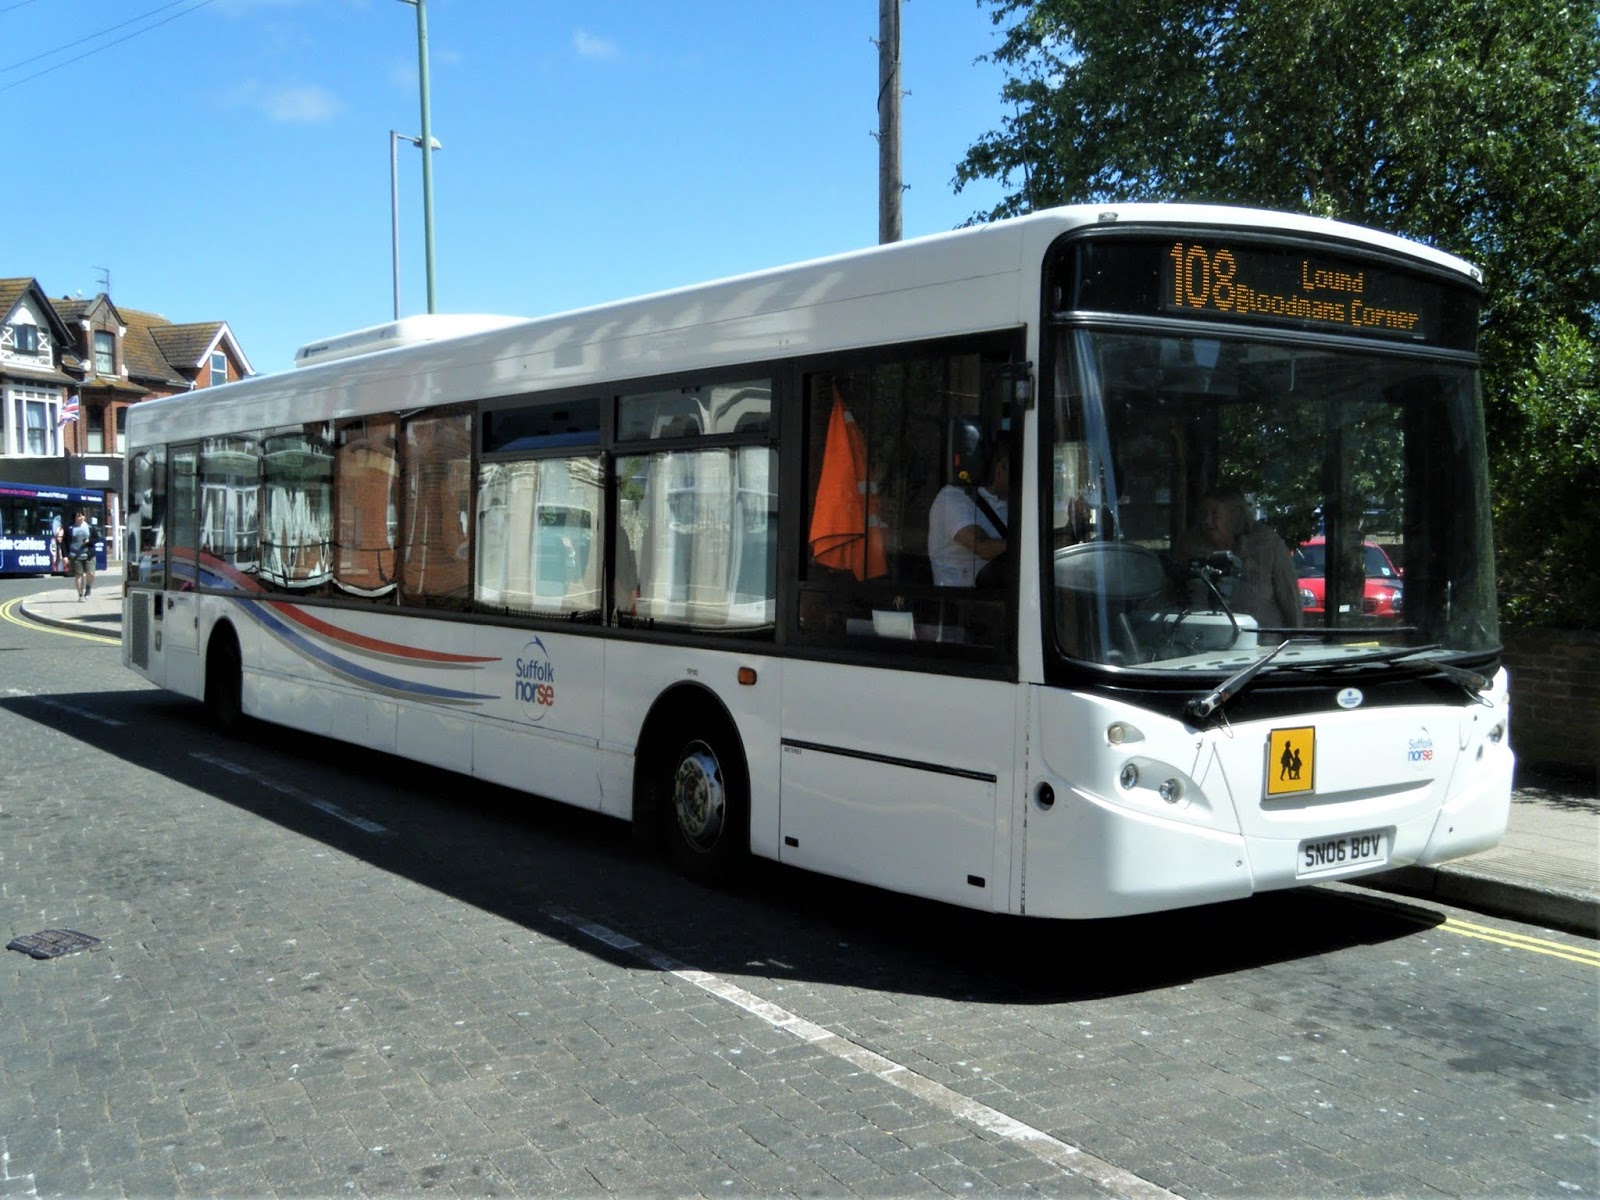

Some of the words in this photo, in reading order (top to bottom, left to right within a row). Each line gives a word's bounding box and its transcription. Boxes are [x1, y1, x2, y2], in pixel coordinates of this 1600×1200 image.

[1170, 242, 1237, 311] 108
[1303, 260, 1363, 293] Lound
[1236, 284, 1345, 322] Bloodmans
[1352, 299, 1419, 330] Corner
[516, 657, 554, 683] Suffolk
[515, 680, 554, 707] norse
[1408, 738, 1433, 750] Suffolk
[1408, 749, 1433, 762] norse
[1305, 839, 1346, 868] SN06
[1350, 834, 1381, 860] BOV
